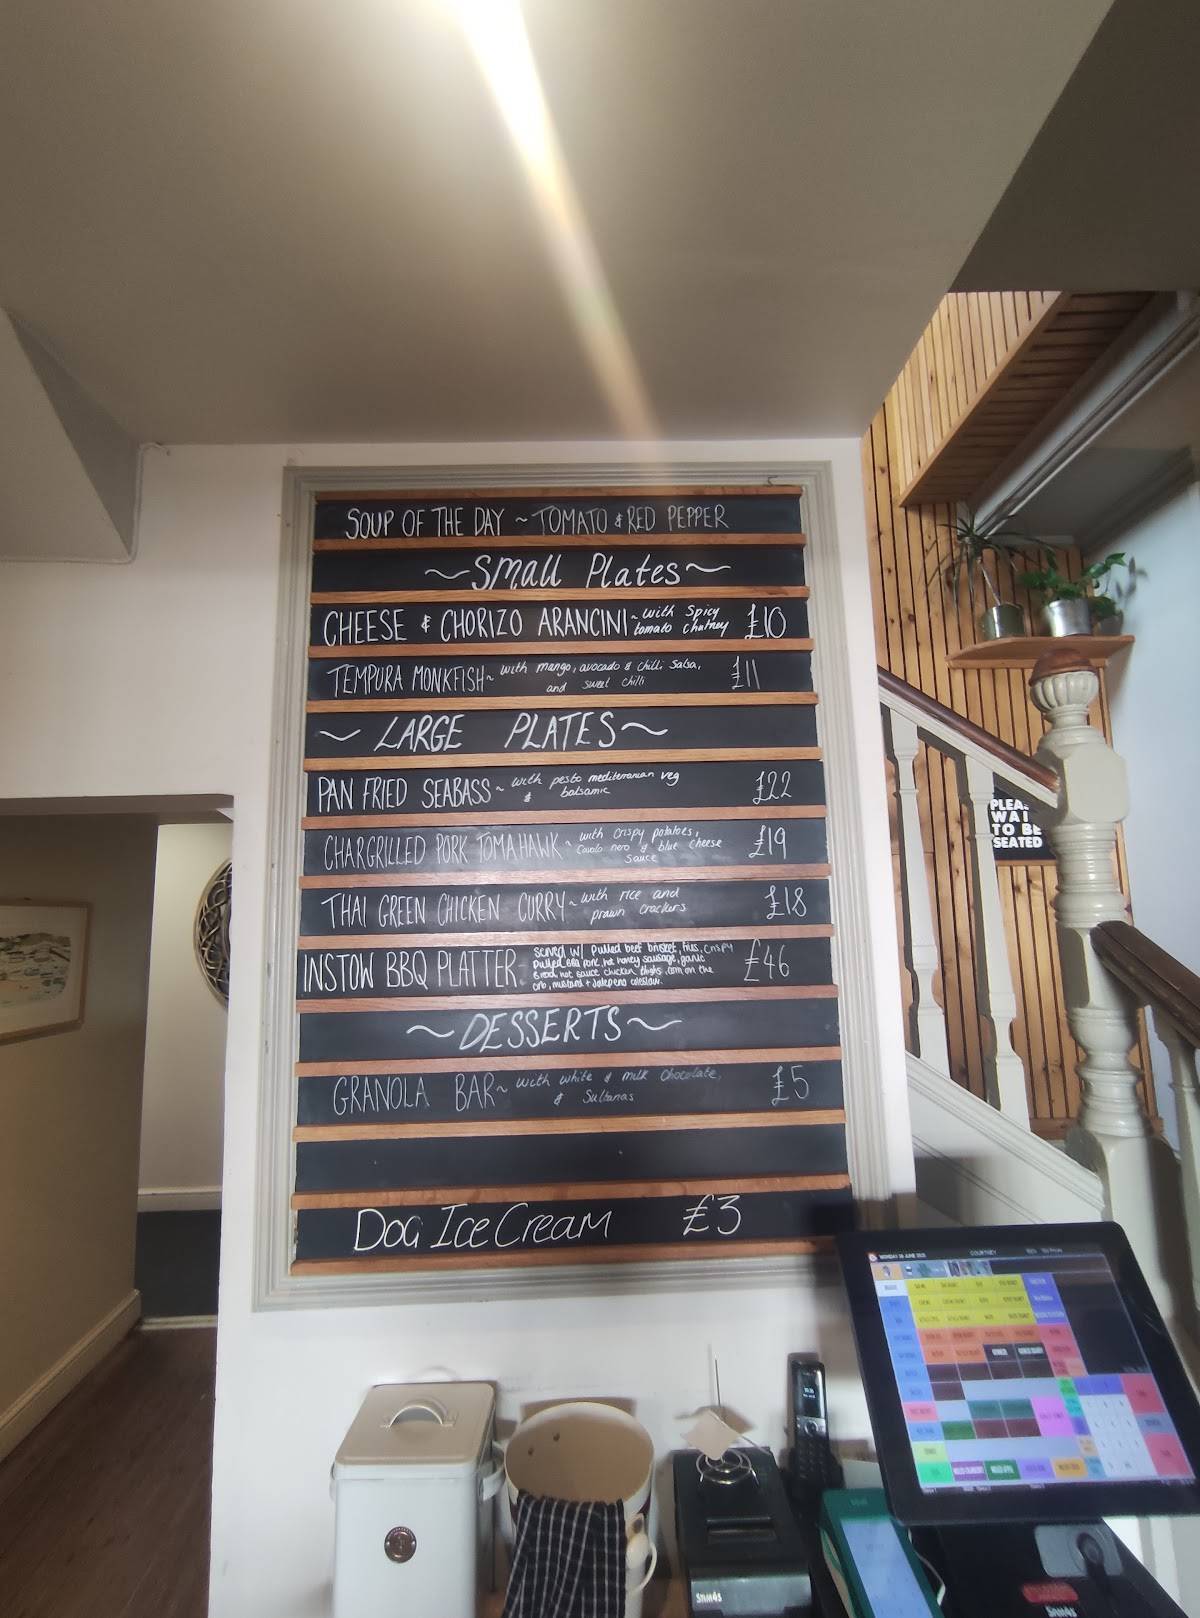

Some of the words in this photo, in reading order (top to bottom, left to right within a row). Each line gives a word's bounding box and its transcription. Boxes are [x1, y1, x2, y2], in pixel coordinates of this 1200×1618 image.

[346, 508, 394, 539] SOUP
[402, 509, 426, 536] OF
[431, 507, 464, 537] THE
[474, 507, 505, 537] DAY
[531, 505, 607, 535] TOMATO
[627, 505, 656, 534] RED
[667, 504, 730, 532] PEPPER
[472, 554, 562, 590] Small
[585, 552, 681, 588] Plates
[324, 608, 407, 646] CHEESE
[440, 607, 523, 643] CHORIZO
[538, 606, 628, 638] ARANCINI
[634, 621, 673, 636] tomato
[642, 604, 675, 619] with
[744, 603, 787, 639] £10
[326, 663, 403, 697] TEMPURA
[412, 665, 485, 694] MONKFISH
[500, 661, 528, 675] with
[579, 661, 620, 673] avocado
[546, 682, 566, 694] and
[582, 676, 610, 690] sweet
[731, 655, 761, 690] £11
[373, 713, 465, 752] LARGE
[504, 711, 616, 751] PLATES
[318, 776, 353, 813] PAN
[363, 776, 408, 811] FRIED
[421, 777, 492, 809] SEABASS
[511, 772, 543, 787] with
[549, 772, 582, 790] pesto
[661, 771, 680, 787] veg
[560, 785, 611, 798] balsamic
[752, 770, 792, 805] £22
[990, 798, 1029, 811] PLEA
[991, 810, 1029, 823] WAI
[579, 827, 603, 842] with
[658, 840, 678, 852] blue
[688, 838, 722, 850] cheese
[748, 825, 787, 860] £19
[992, 823, 1015, 836] TO
[1021, 823, 1042, 836] BE
[993, 836, 1043, 848] SEATED
[324, 835, 426, 871] CHARGRILLED
[436, 833, 470, 864] PORK
[477, 831, 563, 860] TOMAHAWK
[321, 893, 367, 928] THAI
[379, 894, 426, 928] GREEN
[437, 892, 500, 926] CHICKEN
[518, 890, 565, 922] CURRY
[581, 887, 608, 904] with
[620, 889, 642, 901] rice
[652, 887, 680, 900] and
[764, 885, 807, 920] £18
[590, 908, 625, 925] prawn
[303, 951, 374, 993] INSTOW
[386, 950, 429, 990] BBQ
[438, 948, 517, 988] PLATTER
[744, 938, 790, 982] £46
[459, 1005, 621, 1052] DESSERTS
[333, 1076, 430, 1116] GRANOLA
[455, 1072, 495, 1112] BAR
[516, 1073, 550, 1088] with
[560, 1070, 592, 1085] white
[771, 1065, 809, 1106] £5
[430, 1203, 490, 1249] Ice
[683, 1194, 741, 1236] £3
